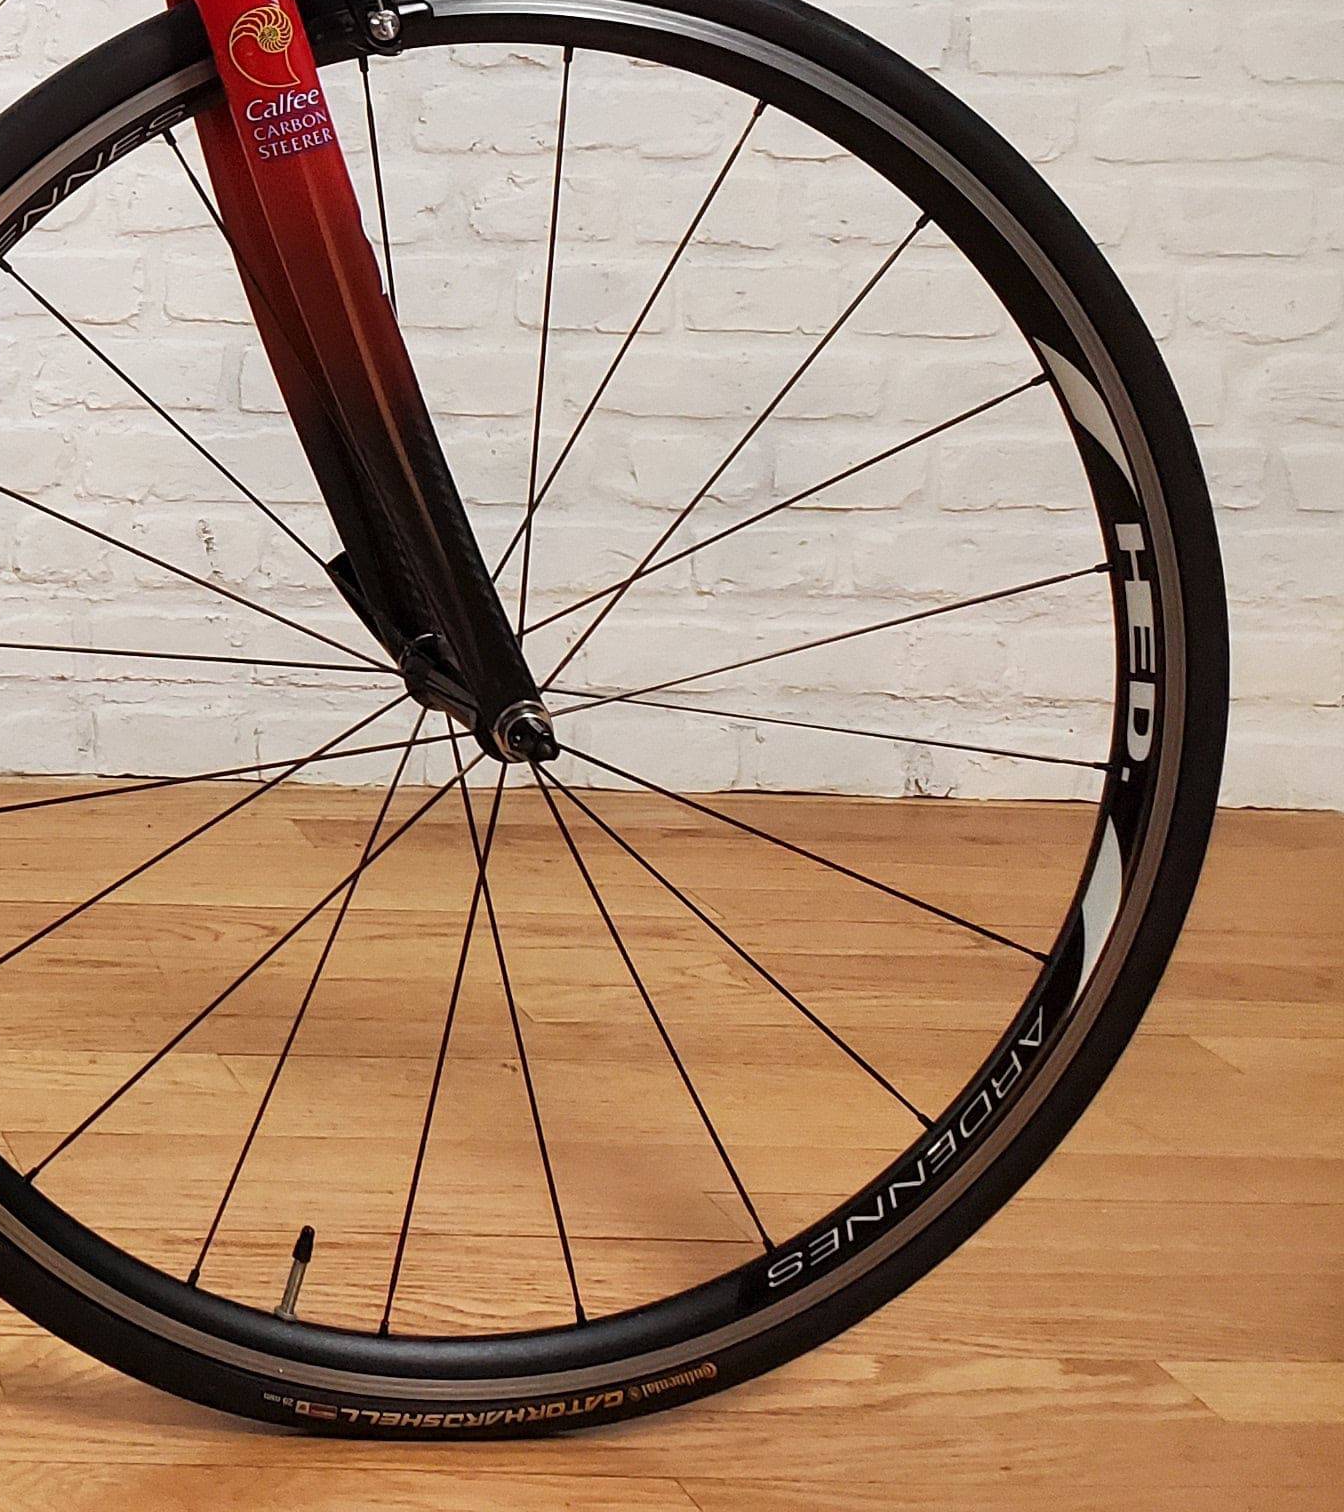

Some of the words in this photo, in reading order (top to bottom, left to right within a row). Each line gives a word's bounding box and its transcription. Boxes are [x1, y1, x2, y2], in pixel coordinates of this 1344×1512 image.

[246, 88, 319, 121] Calfee
[254, 110, 328, 140] CARBON
[258, 127, 333, 159] STEERER
[768, 1005, 1044, 1287] ARDENNES
[340, 1390, 624, 1428] GATORHARDSHELL
